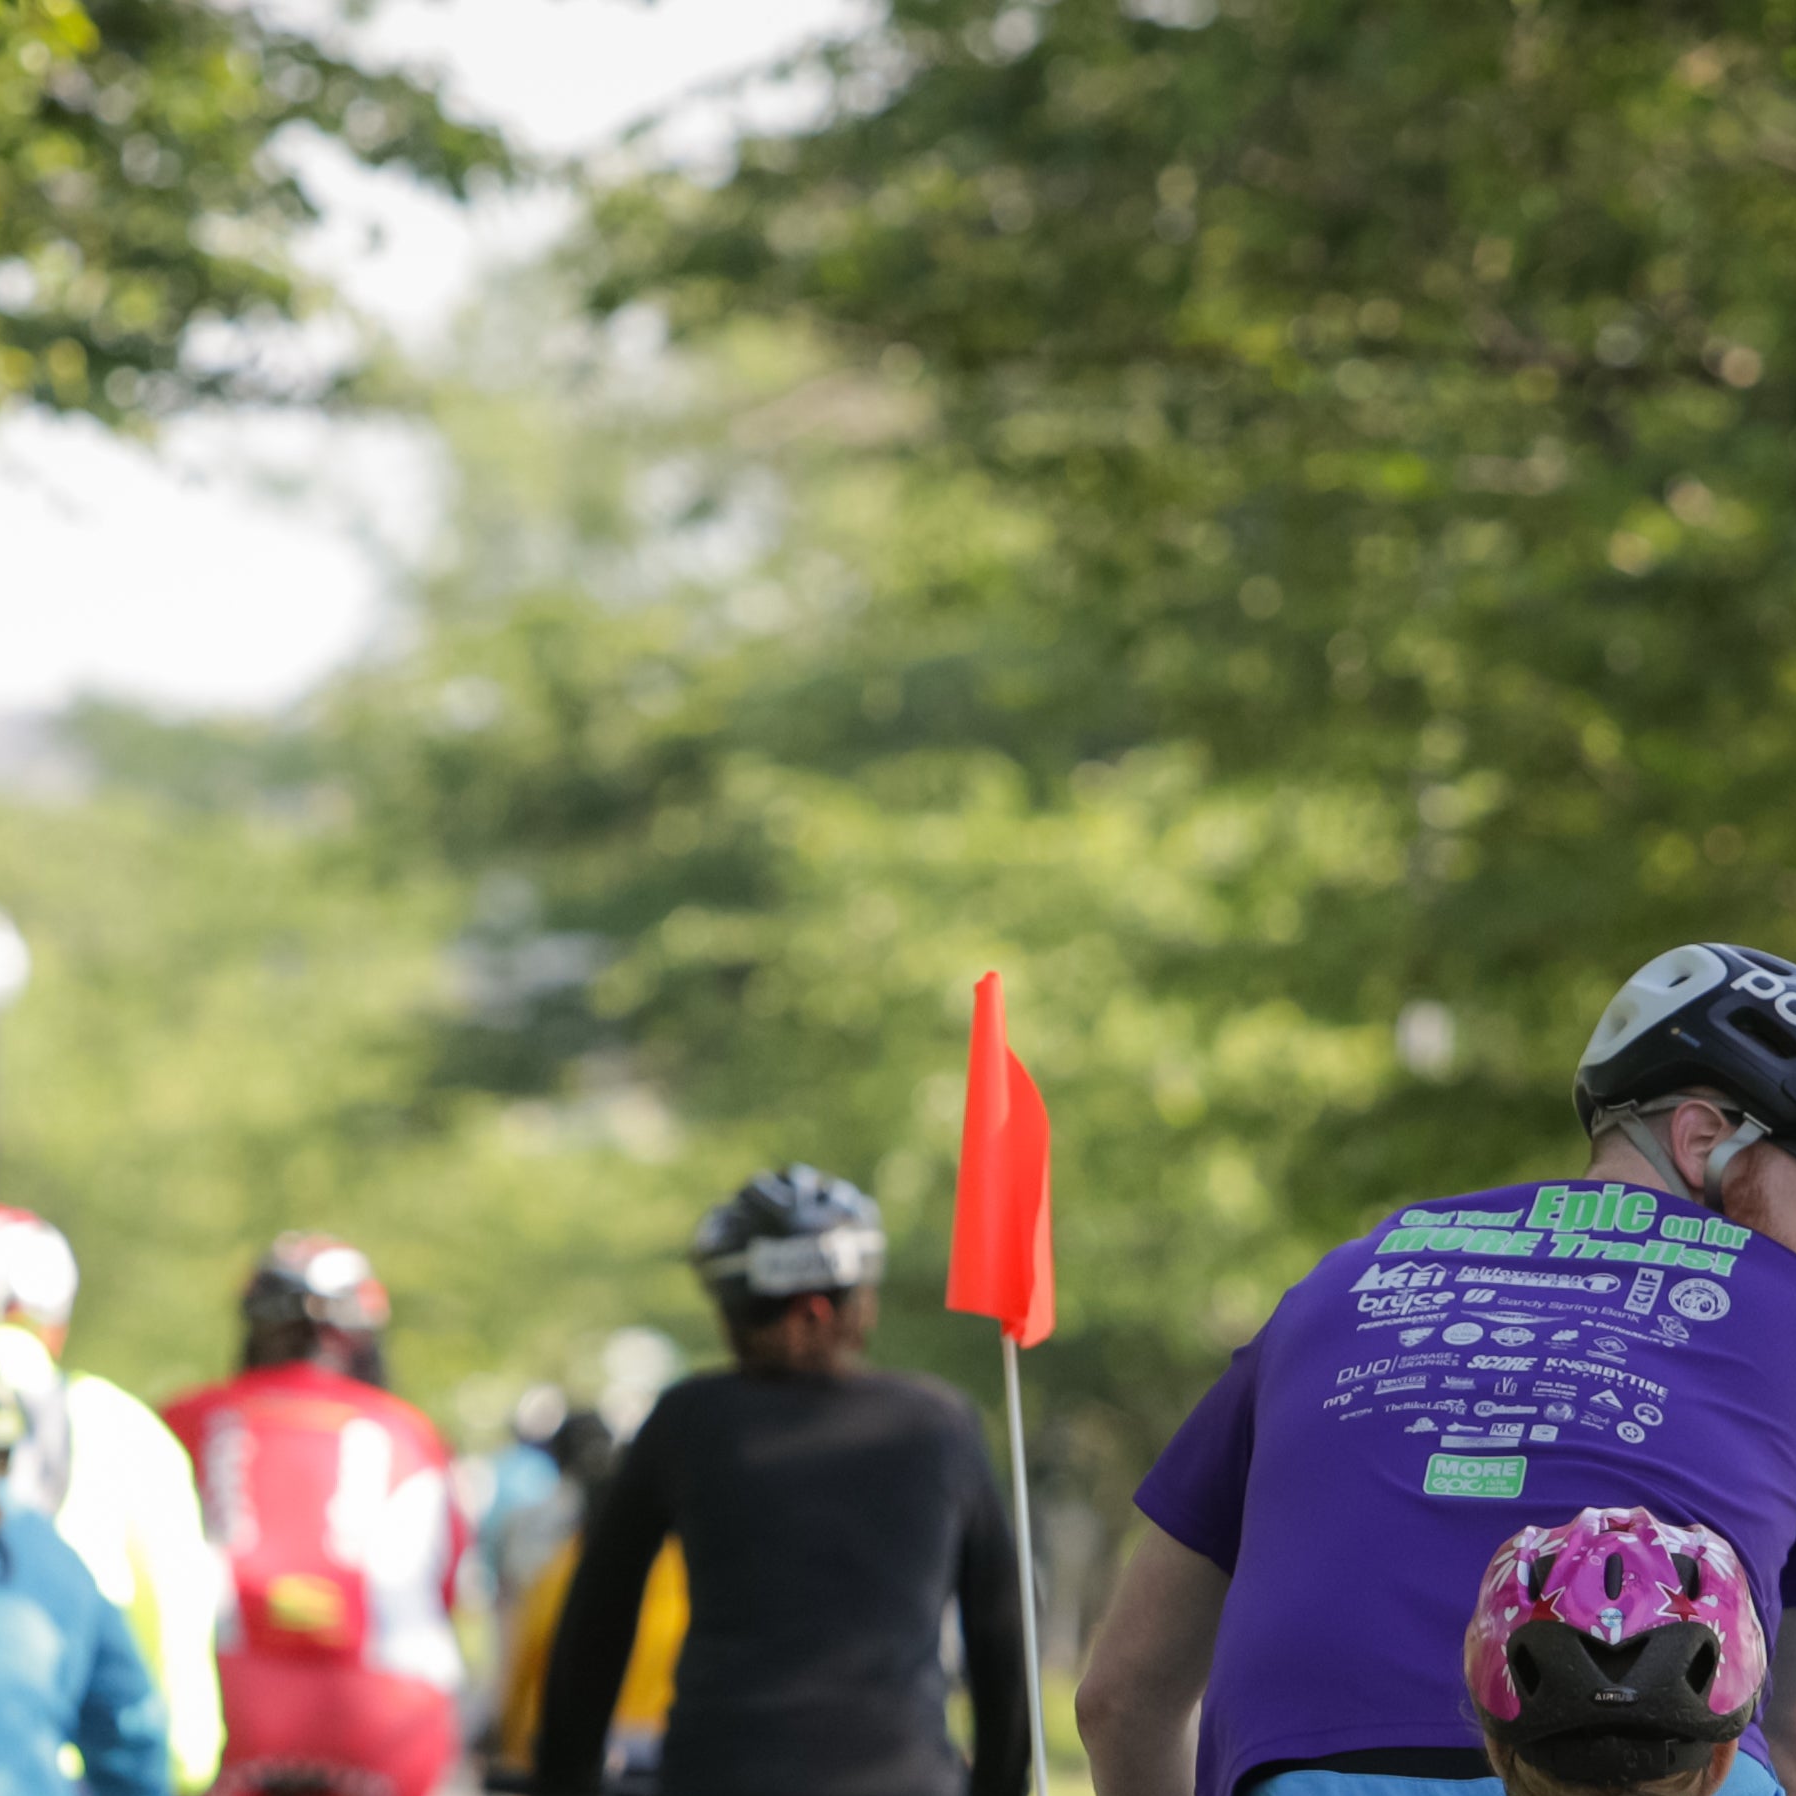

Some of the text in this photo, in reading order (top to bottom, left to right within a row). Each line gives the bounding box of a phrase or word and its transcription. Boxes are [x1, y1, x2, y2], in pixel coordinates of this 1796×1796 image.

[1400, 1184, 1752, 1250] Get Your Epic on for
[1374, 1226, 1737, 1277] MORE Trails!
[1377, 1266, 1447, 1290] REI
[1632, 1272, 1658, 1304] CLIF
[1357, 1290, 1455, 1315] bryce
[1497, 1297, 1546, 1309] Sandy
[1548, 1302, 1597, 1314] Spring
[1601, 1306, 1641, 1323] Bank
[1336, 1359, 1391, 1384] DUO
[1467, 1355, 1538, 1371] SCORE
[1545, 1357, 1669, 1397] KNOBBYTIRE
[1491, 1424, 1520, 1435] MC
[1434, 1459, 1519, 1477] MORE
[1432, 1477, 1483, 1493] epic
